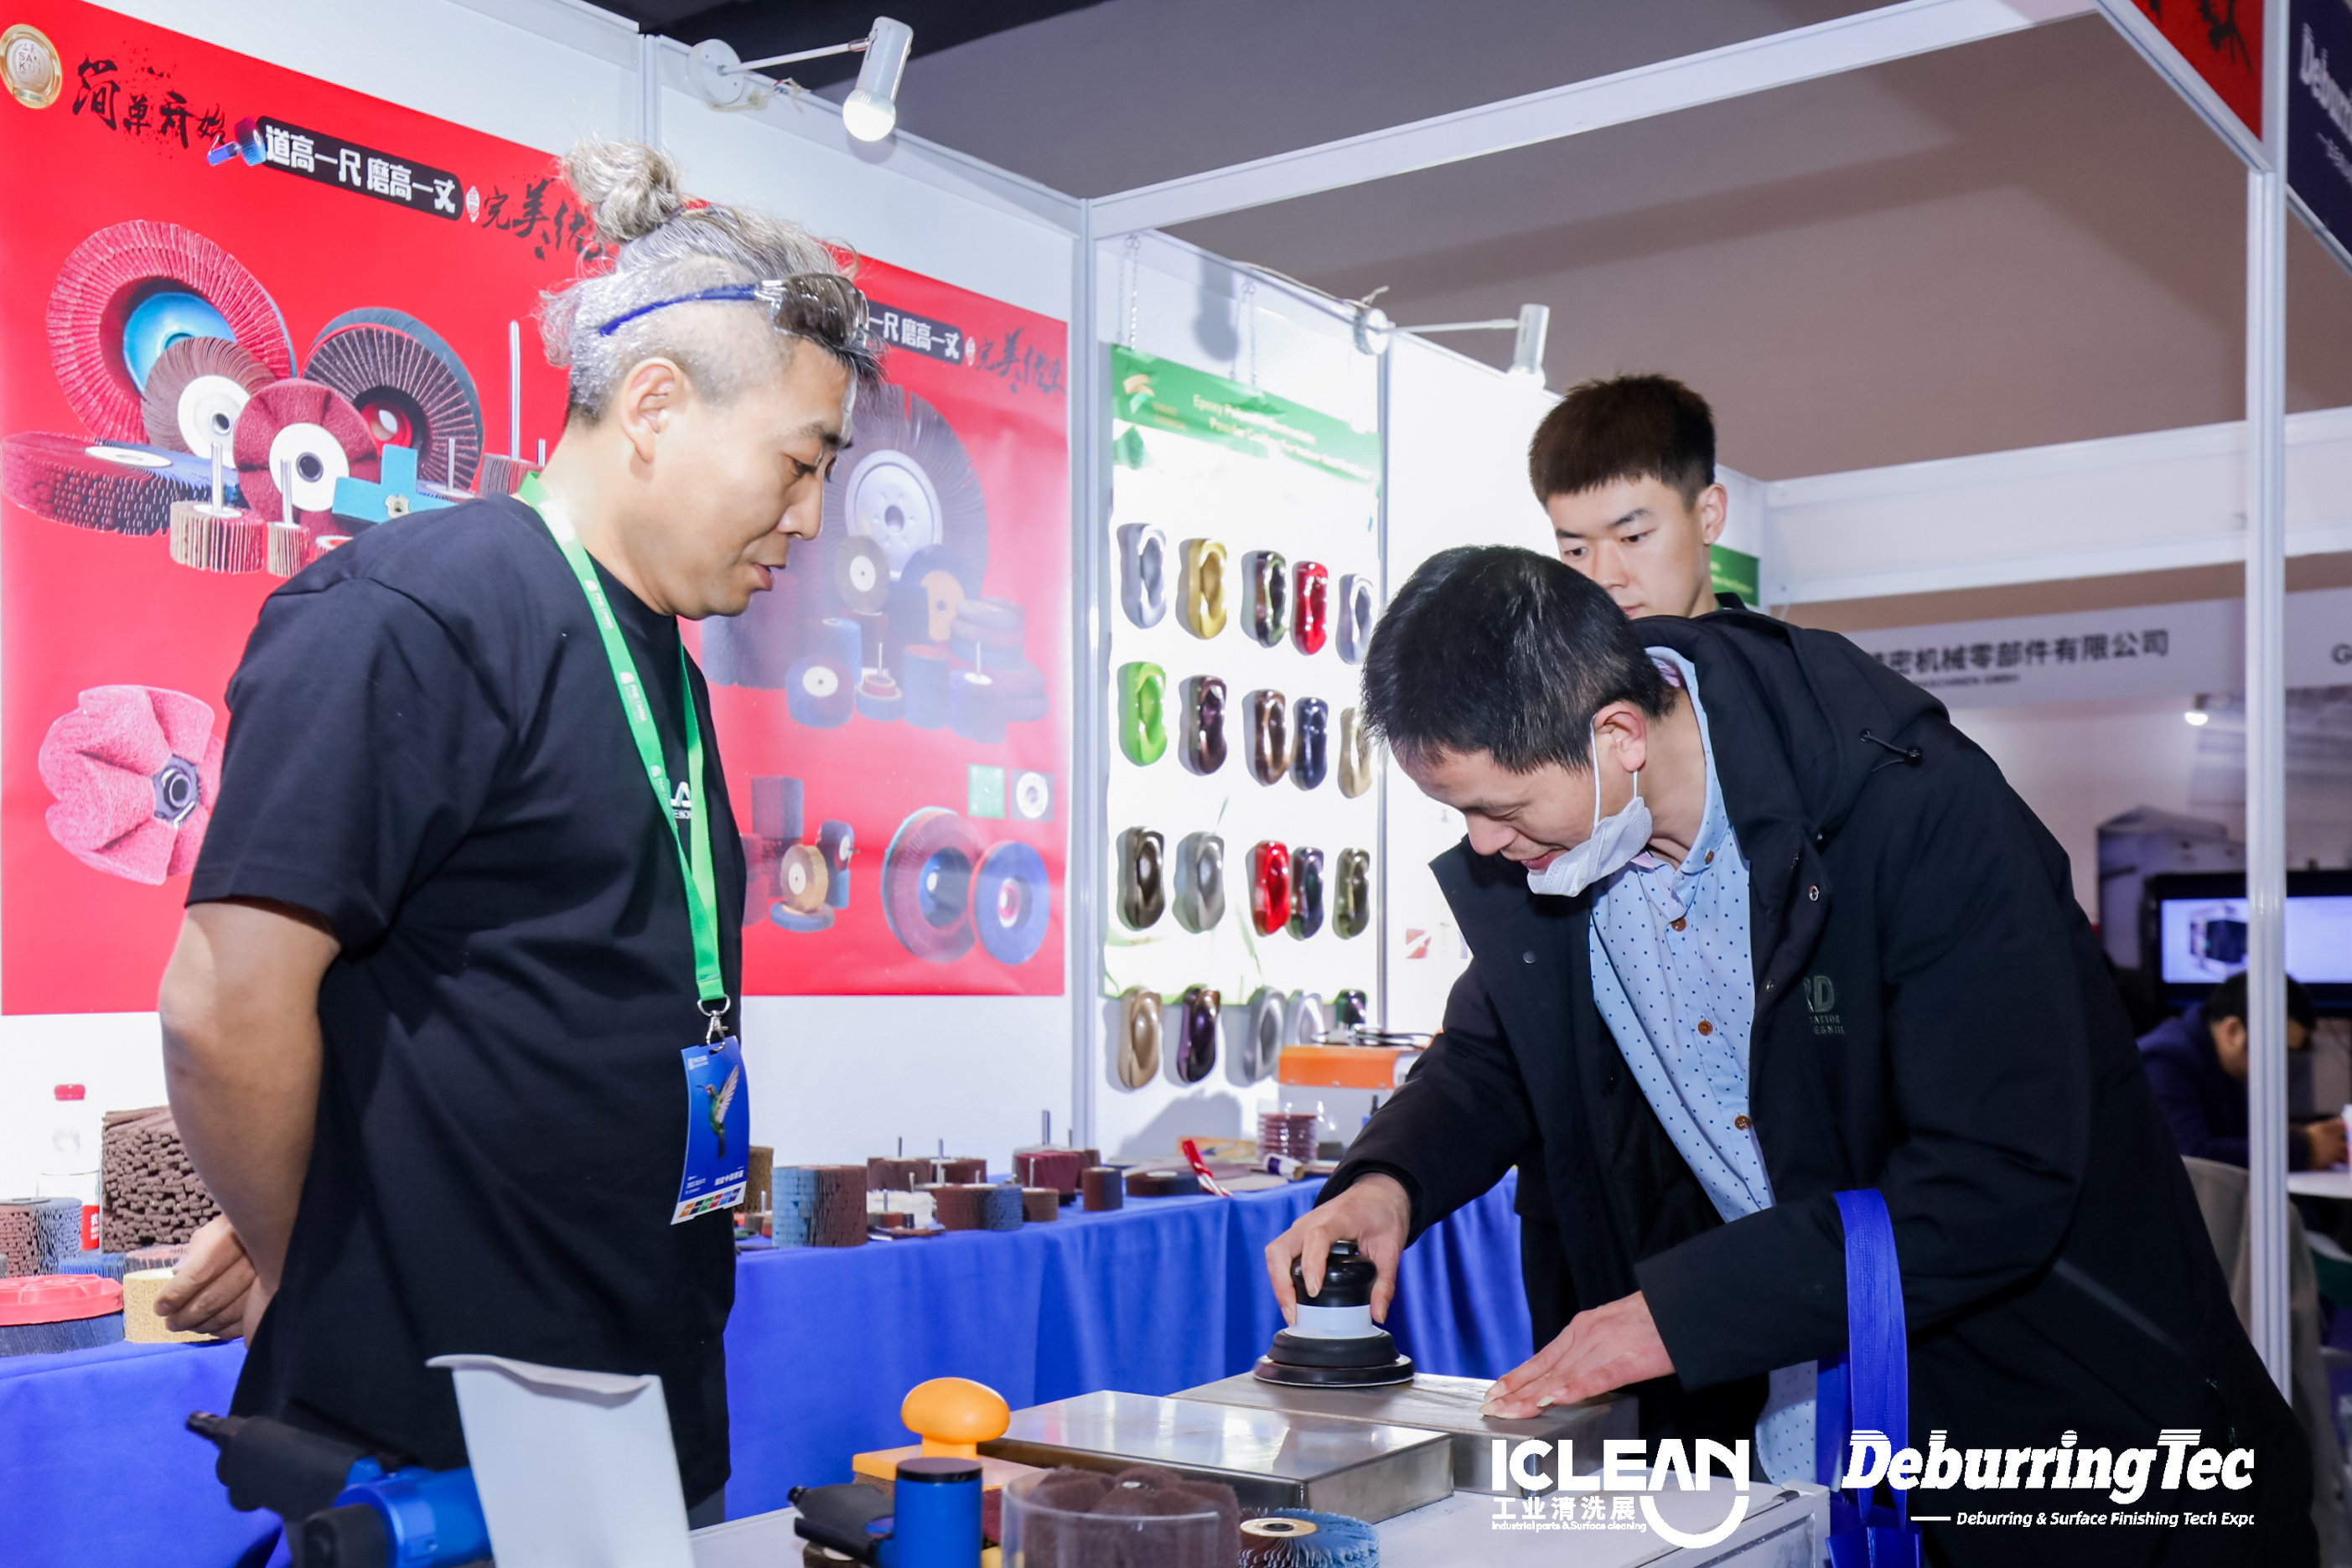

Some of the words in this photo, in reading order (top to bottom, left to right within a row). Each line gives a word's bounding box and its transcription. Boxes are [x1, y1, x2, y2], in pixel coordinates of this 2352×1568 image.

[18, 51, 41, 65] SAN
[265, 124, 362, 188] 道高一尺
[366, 156, 456, 215] 磨高一丈
[901, 317, 961, 361] 磨高一丈
